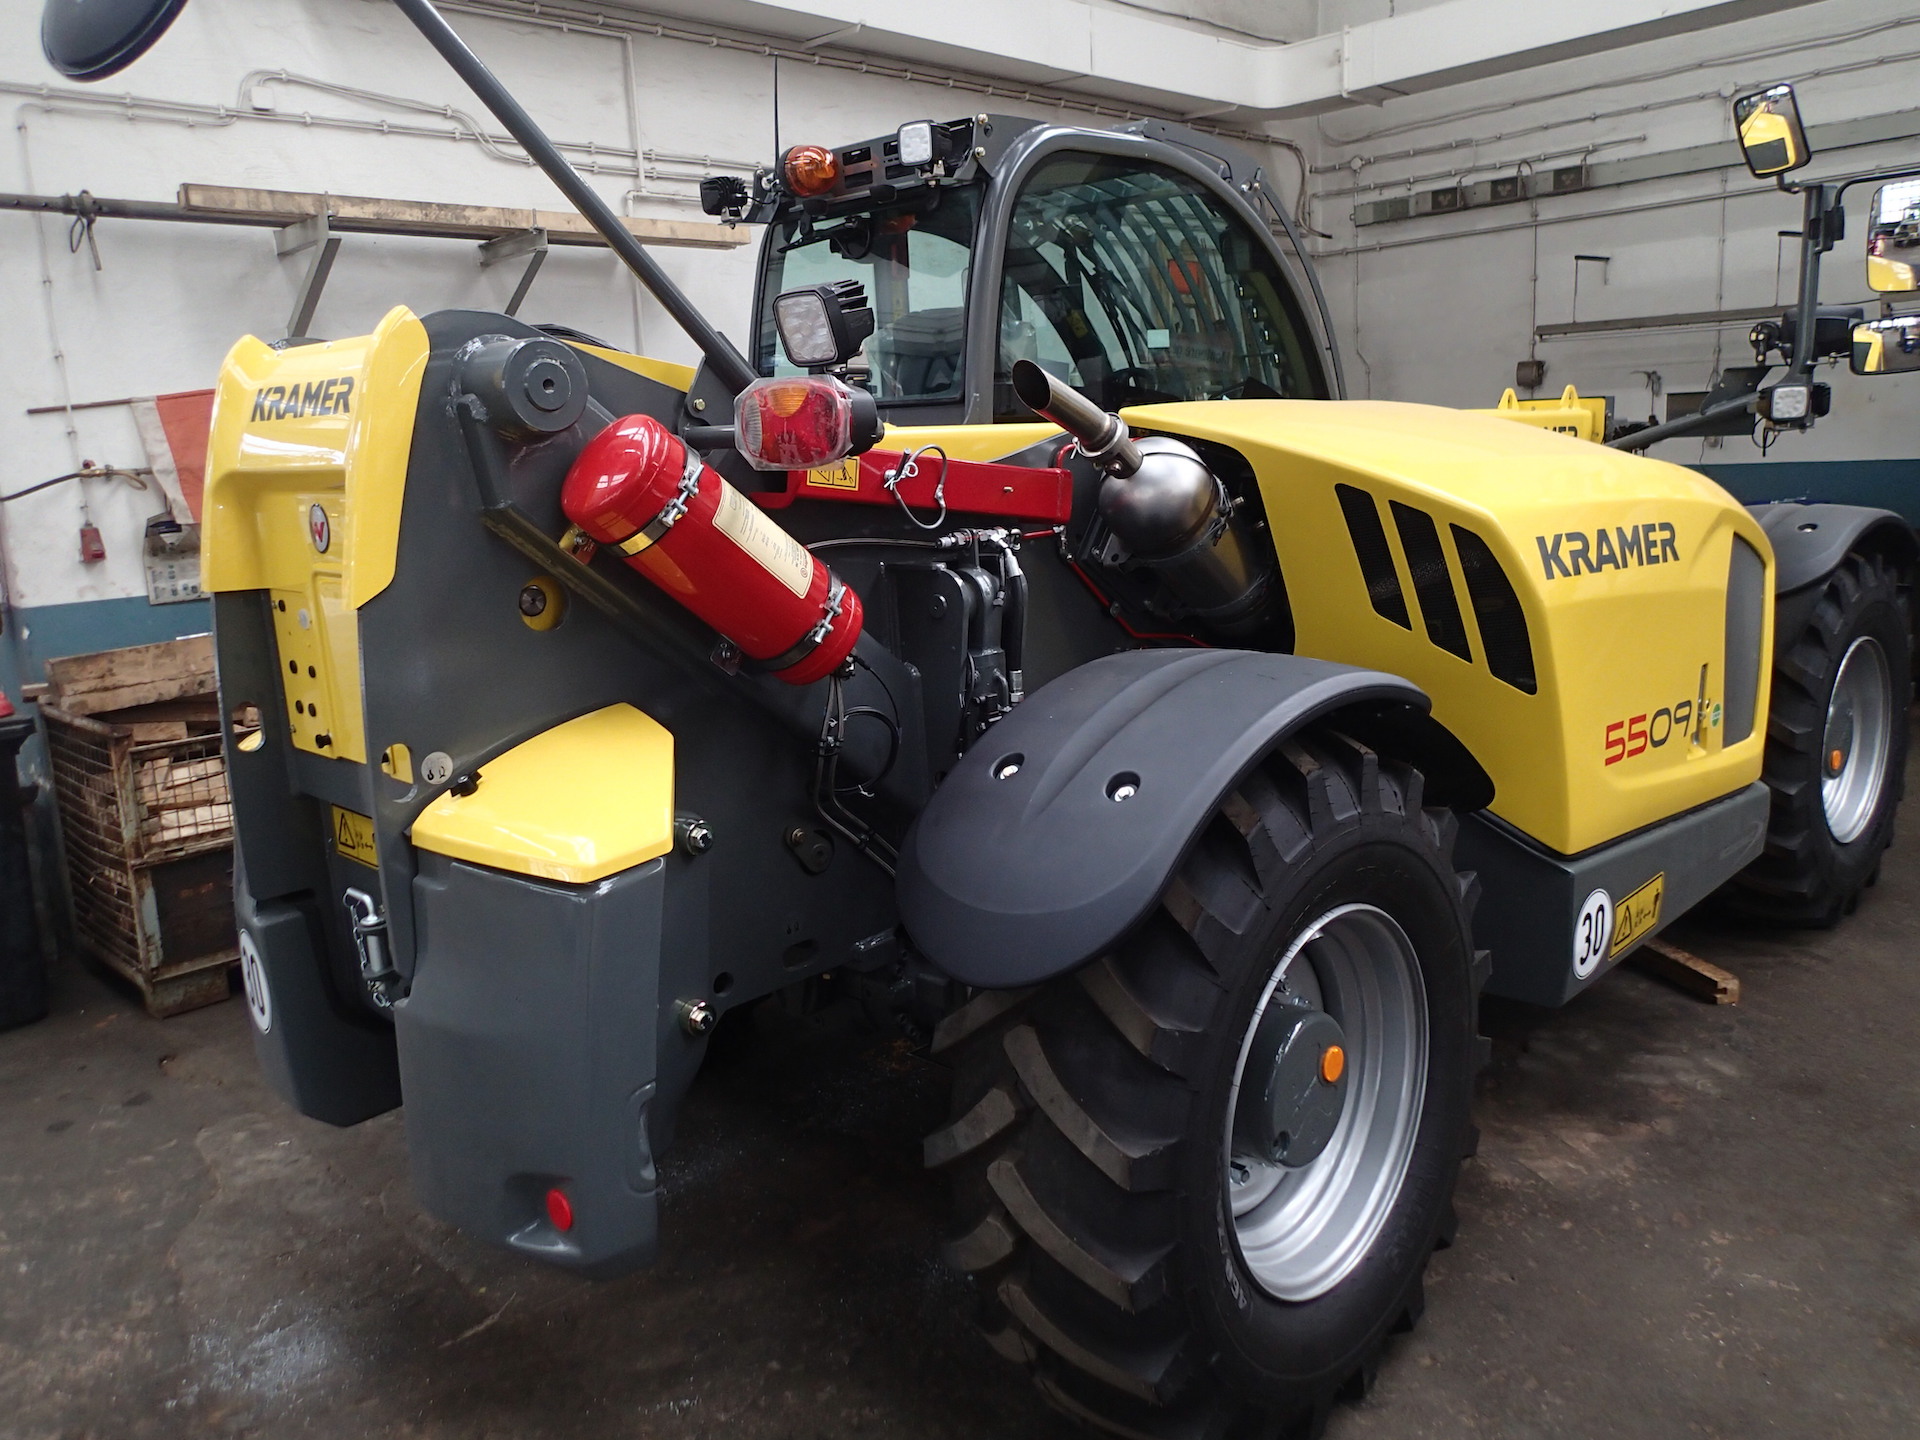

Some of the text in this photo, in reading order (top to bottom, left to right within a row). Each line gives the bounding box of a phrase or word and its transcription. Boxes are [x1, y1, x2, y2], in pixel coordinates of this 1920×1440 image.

[250, 376, 354, 422] KRAMER
[1535, 522, 1680, 580] KRAMER
[1604, 699, 1692, 766] 5509
[1579, 903, 1605, 966] 30
